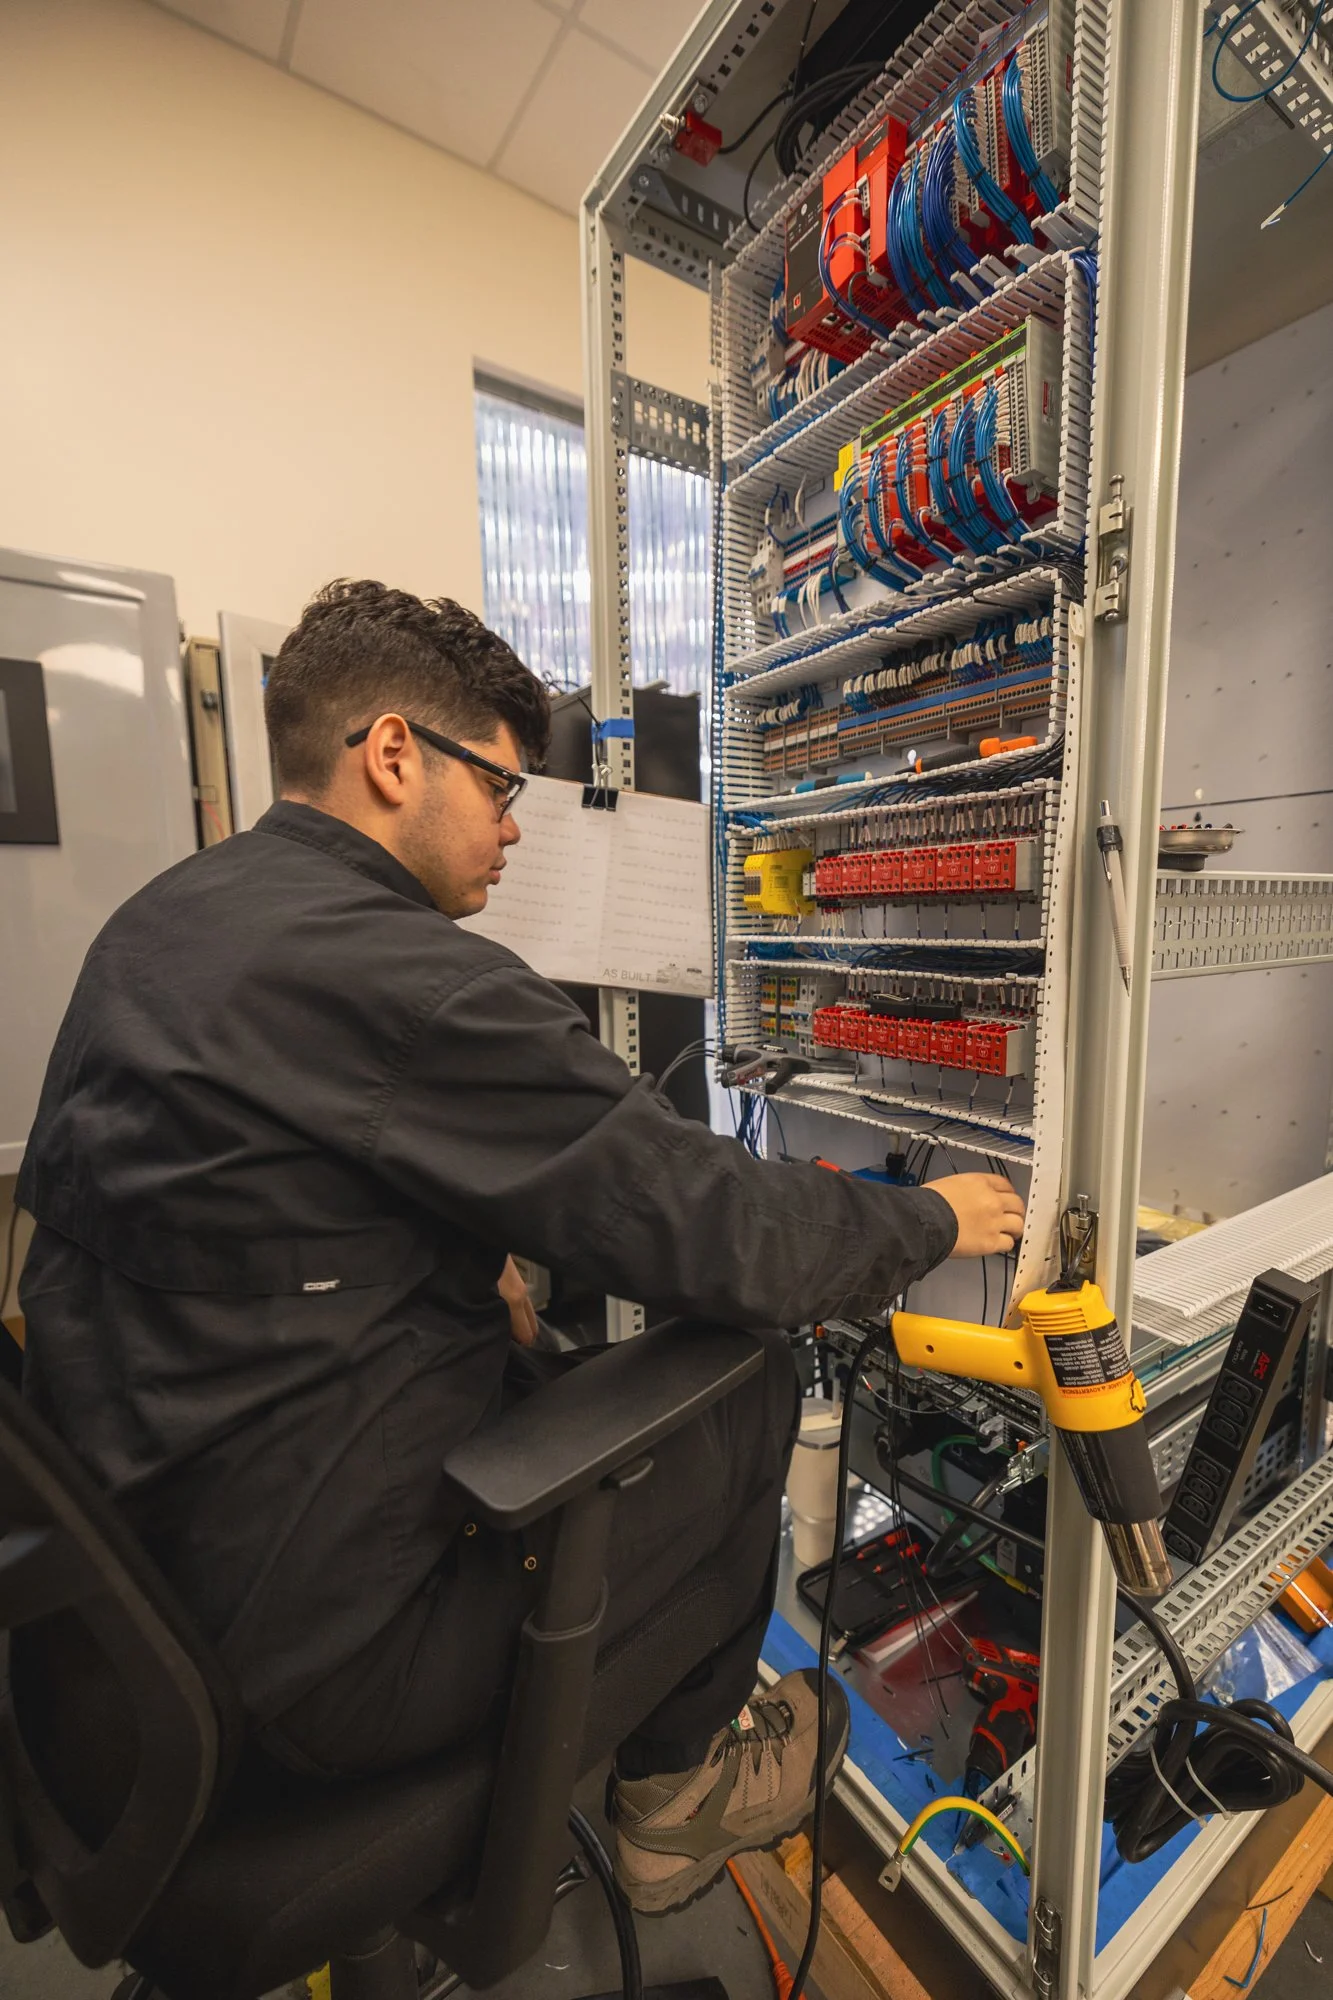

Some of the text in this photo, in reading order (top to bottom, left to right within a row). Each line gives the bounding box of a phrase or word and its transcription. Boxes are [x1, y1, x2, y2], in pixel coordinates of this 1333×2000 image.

[603, 968, 618, 978] AS
[621, 969, 651, 982] BUILT
[1254, 1351, 1270, 1380] APC
